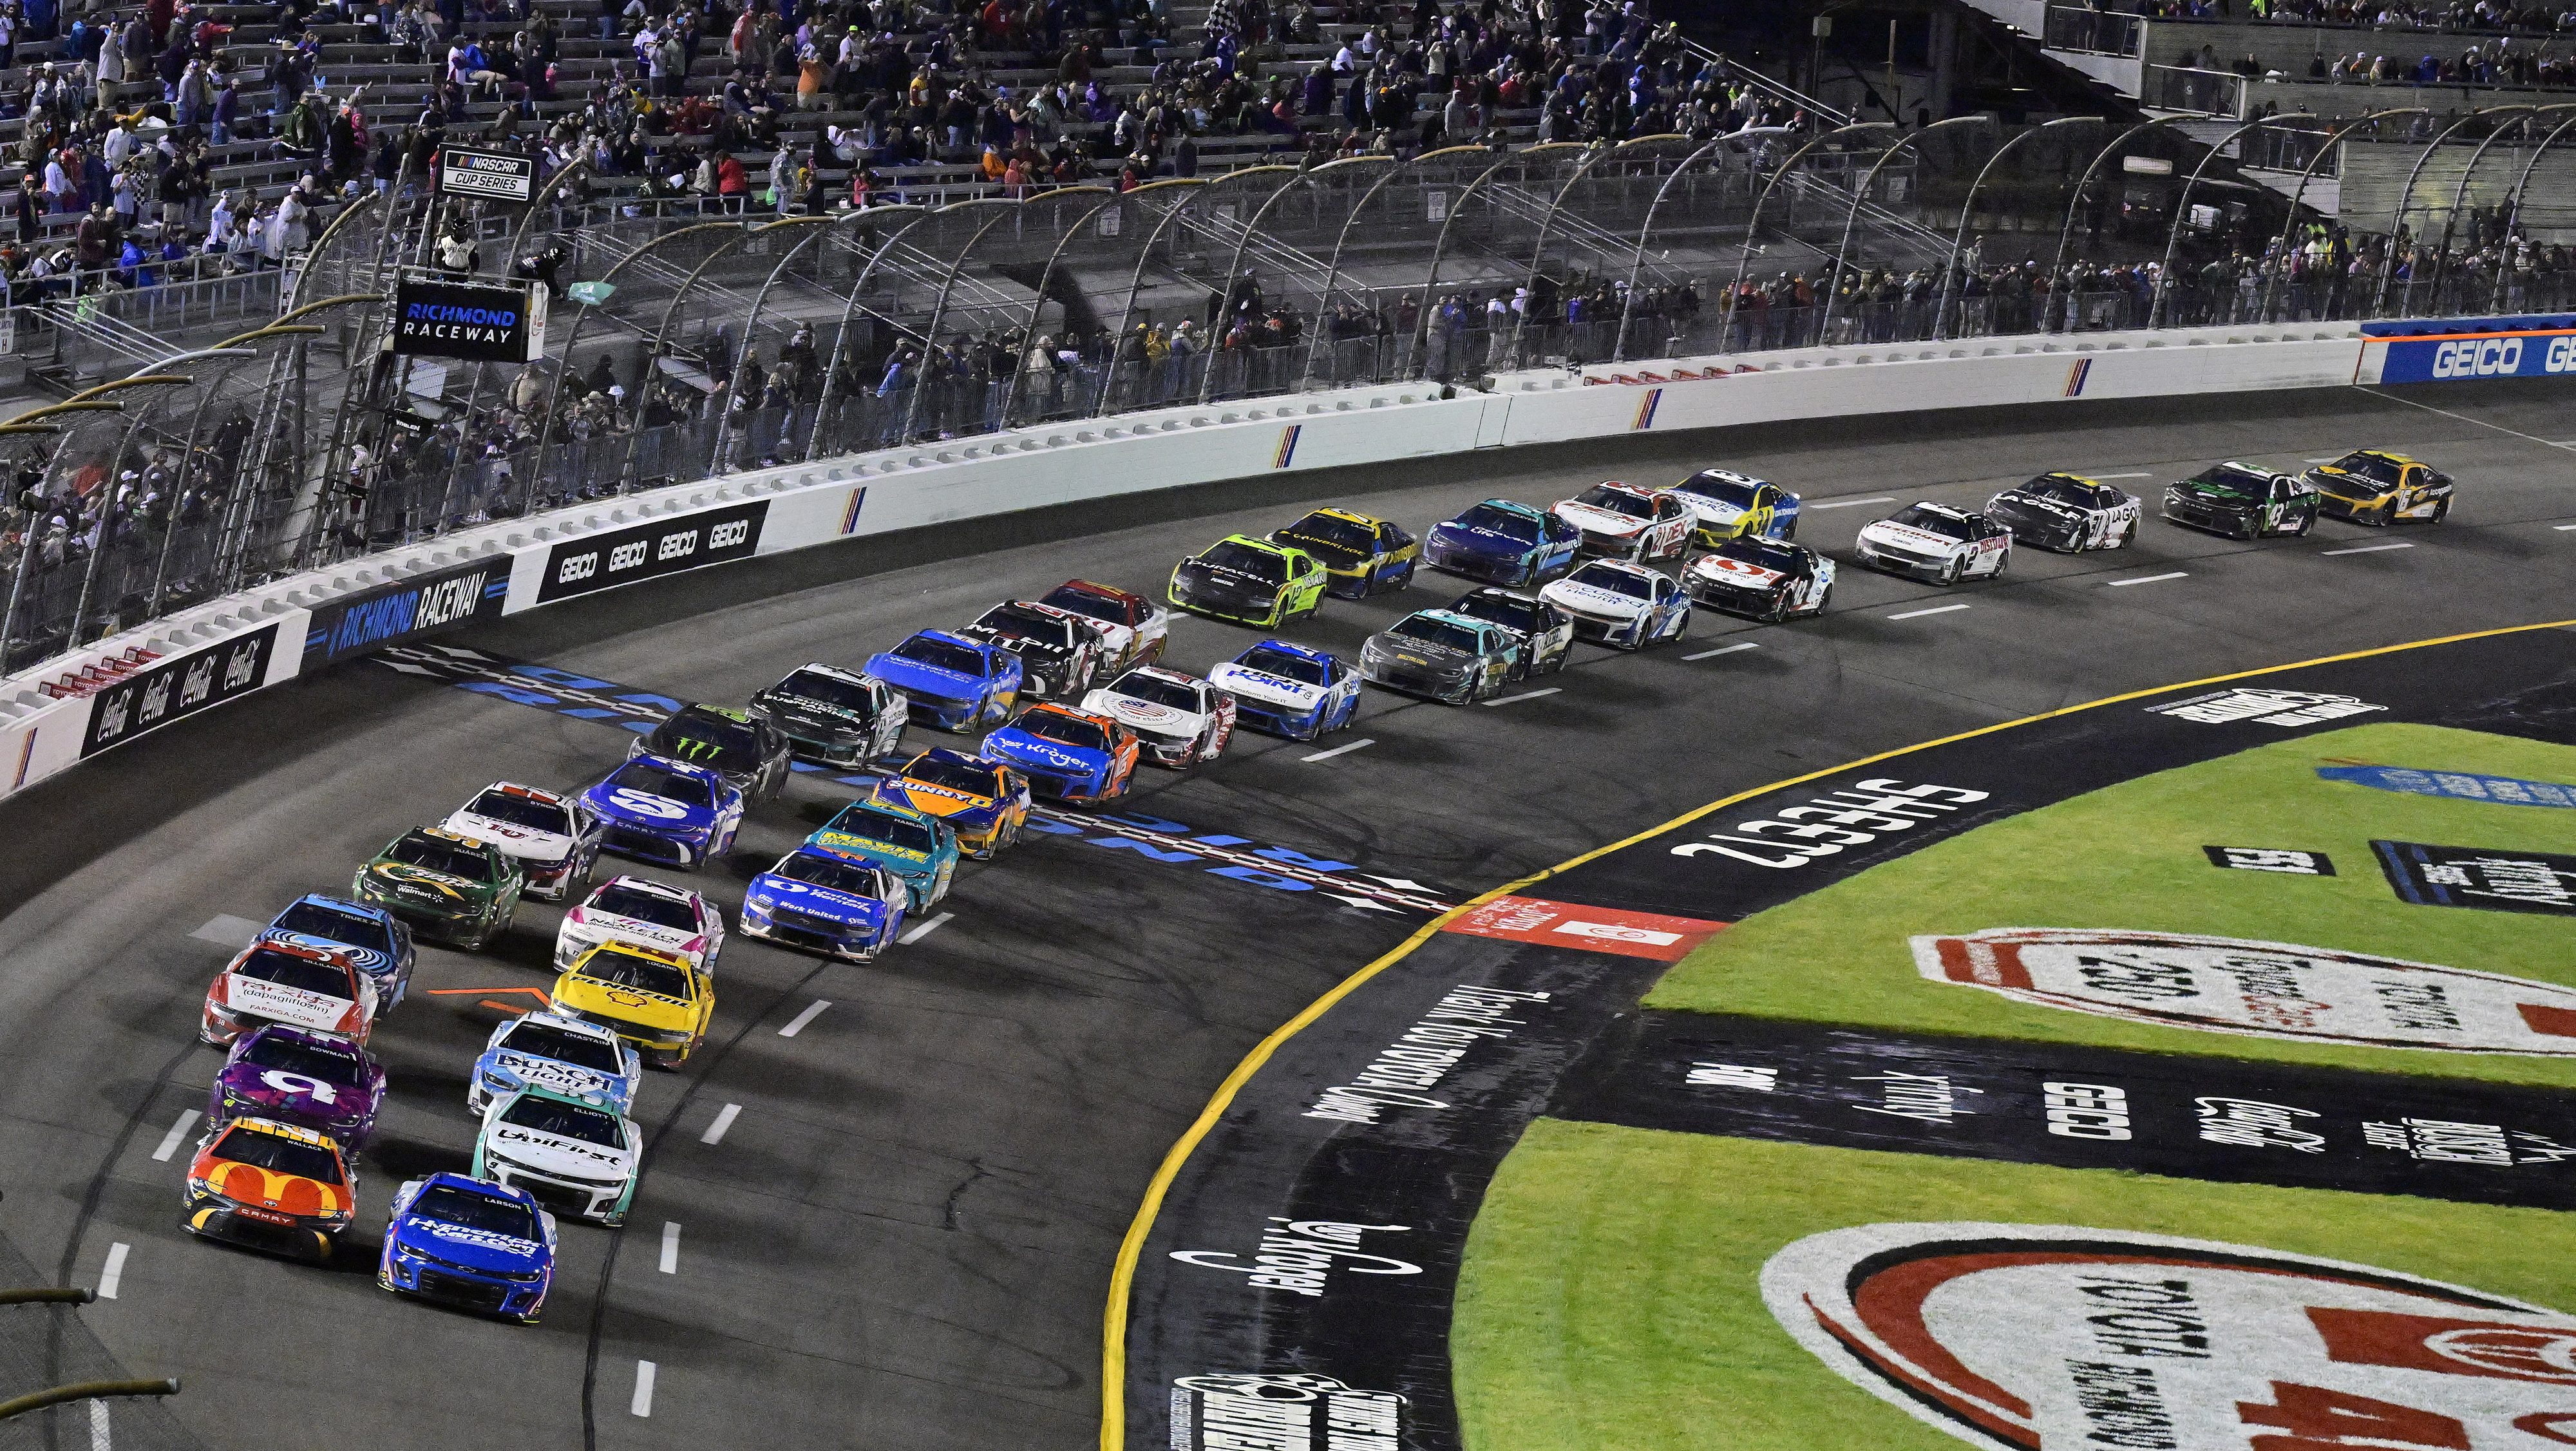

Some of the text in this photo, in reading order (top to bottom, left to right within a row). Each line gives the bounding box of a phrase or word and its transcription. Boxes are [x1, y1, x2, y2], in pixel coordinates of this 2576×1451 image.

[471, 156, 519, 174] NASCAR
[455, 172, 518, 191] CUP SERIES
[407, 303, 516, 327] RICHMOND
[403, 321, 511, 343] RACEWAY
[2432, 337, 2523, 379] GEICO
[2022, 498, 2081, 521] GOLF
[1470, 527, 1494, 538] Life
[1474, 526, 1534, 547] Delaware
[1874, 523, 1953, 547] DISCOUNT
[559, 519, 748, 583] GEICO GEICO GEICO GEICO
[1293, 533, 1365, 557] GAINBRIDGE
[1964, 545, 1979, 571] 2
[1188, 560, 1276, 586] DURACELL
[1714, 567, 1752, 580] SAFEWAY
[1289, 585, 1303, 611] 12
[1566, 588, 1618, 605] Health
[1708, 582, 1739, 593] CAMRY
[339, 571, 487, 651] RICHMOND RACEWAY
[1508, 602, 1531, 612] BUSCH
[1045, 618, 1063, 627] BELL
[1452, 624, 1476, 635] DILLON
[955, 646, 975, 654] HALEY
[1162, 681, 1190, 691] GRAGSON
[1226, 669, 1309, 694] POINT
[1228, 685, 1262, 698] Transform
[1263, 694, 1279, 703] Your
[762, 694, 861, 725] SUBMARINES
[1026, 744, 1090, 768] Kroger
[530, 801, 557, 811] BYRON
[616, 821, 658, 835] CAMRY
[893, 818, 925, 830] HAMLIN
[397, 885, 432, 899] Walmart
[651, 893, 688, 906] BUESCHER
[809, 891, 871, 913] Rentals
[811, 888, 870, 907] United
[339, 913, 368, 925] TRUEX
[779, 900, 841, 921] Work United
[1492, 912, 1558, 931] TOYOTA
[303, 958, 342, 972] GILLILAND
[646, 960, 677, 971] LOGANO
[2079, 956, 2201, 998] 250
[569, 976, 694, 1009] PENNZOIL
[249, 1003, 315, 1024] FARXIGA.COM
[2370, 980, 2465, 1032] TOYOTA
[216, 1018, 225, 1027] 38
[564, 1031, 610, 1047] CHASTAIN
[310, 1046, 350, 1060] BOWMAN
[1300, 984, 1552, 1125] Thank You TOYOTA Owners
[495, 1054, 614, 1092] BUSCH
[518, 1068, 588, 1088] LIGHT
[1685, 1061, 1778, 1092] FOX
[223, 1098, 236, 1108] 48
[1850, 1069, 1985, 1124] xfinity
[573, 1107, 609, 1120] ELLIOTT
[2041, 1081, 2133, 1142] GEICO
[2193, 1096, 2325, 1152] Coca-Cola
[287, 1139, 323, 1152] WALLACE
[2362, 1121, 2410, 1150] LIGHT
[2401, 1117, 2514, 1166] BUSCH
[497, 1128, 622, 1167] UniFirst
[488, 1161, 498, 1169] 9
[484, 1197, 522, 1211] LARSON
[240, 1208, 292, 1224] CAMRY
[1168, 1235, 1424, 1297] Kroger
[2076, 1275, 2212, 1360] TOYOTA
[2062, 1358, 2178, 1450] RICHMOND
